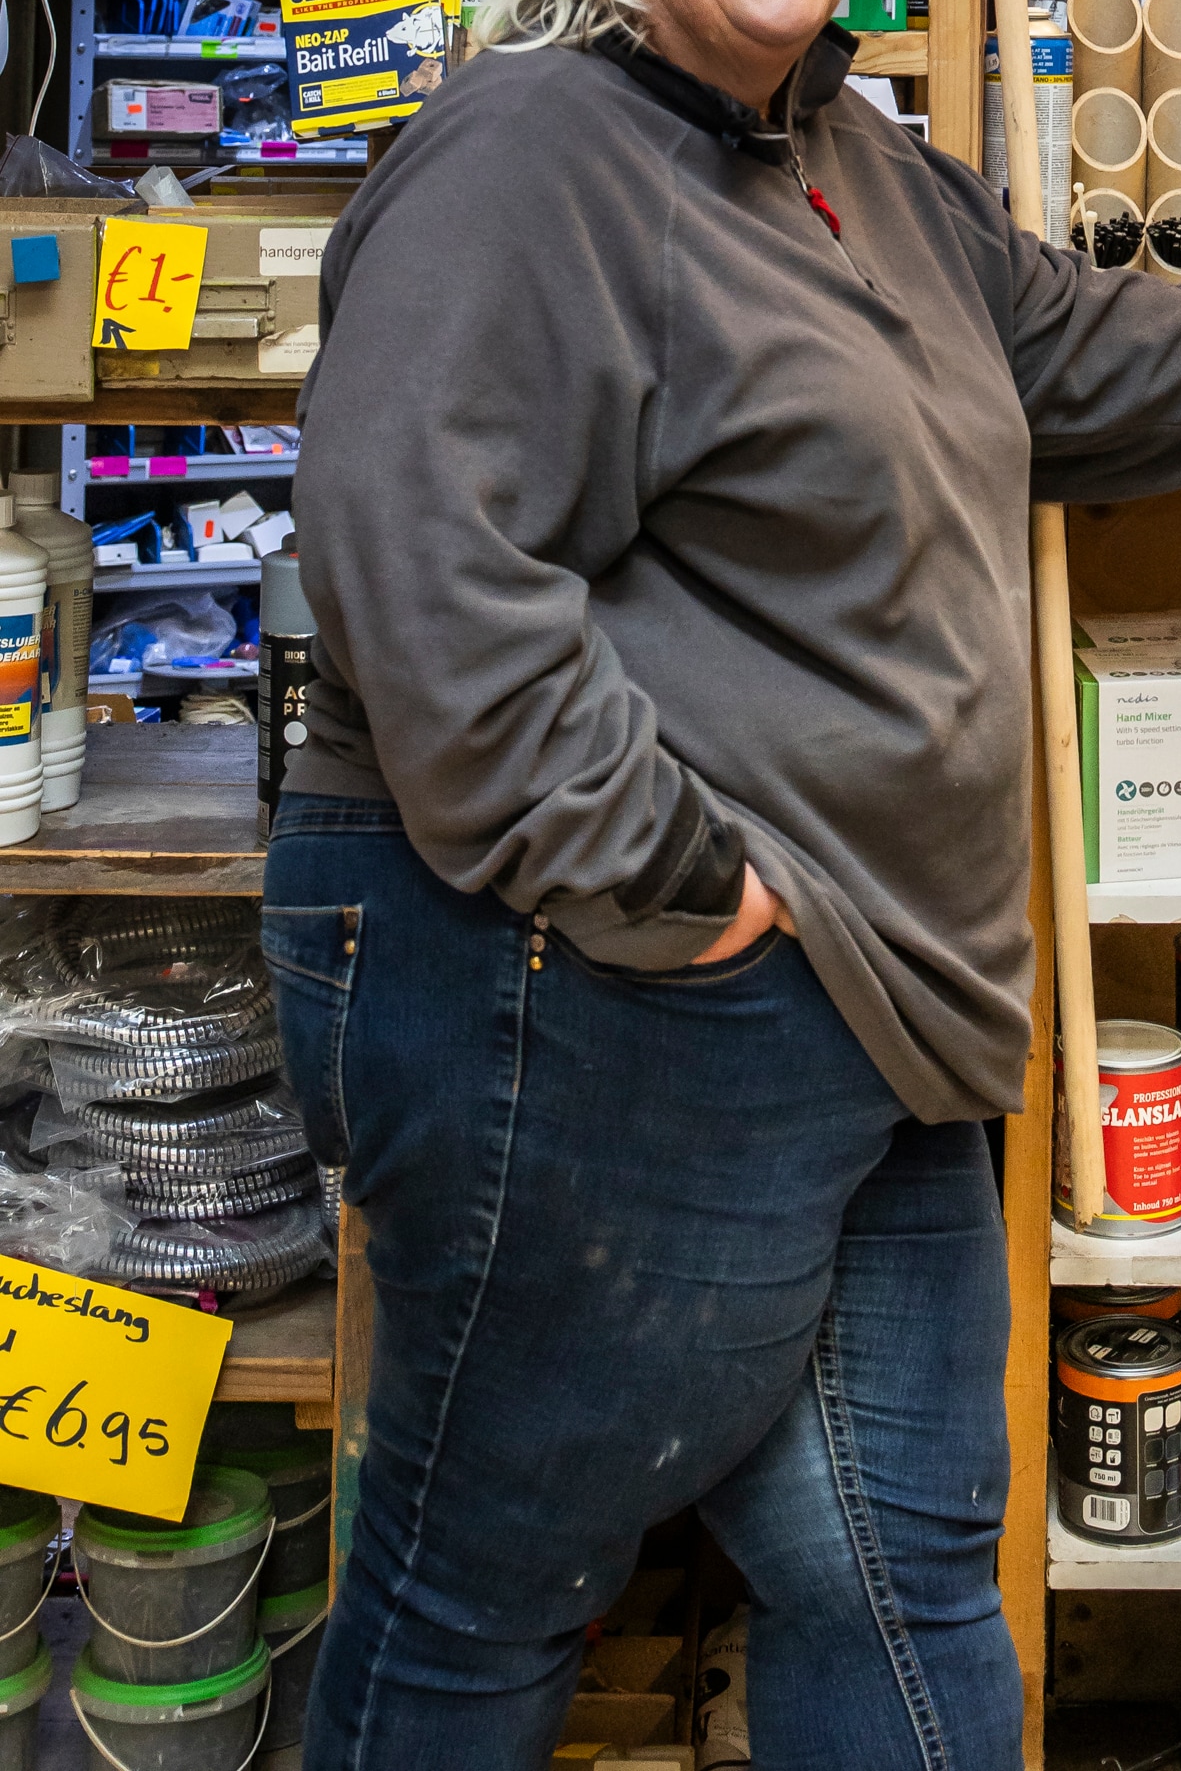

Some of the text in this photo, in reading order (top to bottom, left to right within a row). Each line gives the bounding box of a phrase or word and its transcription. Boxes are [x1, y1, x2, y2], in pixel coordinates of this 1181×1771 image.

[295, 5, 315, 14] LIKE
[317, 2, 334, 12] THE
[295, 28, 350, 49] NEO-ZAP
[296, 37, 390, 74] Bait Refill
[302, 89, 322, 98] CATCH
[1116, 694, 1159, 704] nedis
[1116, 711, 1173, 722] Hand Mixer
[1116, 725, 1132, 734] With
[1140, 725, 1161, 736] speed
[1116, 736, 1164, 746] turbo function
[1117, 834, 1142, 843] Batteur
[1133, 1196, 1174, 1211] Inhoud 750
